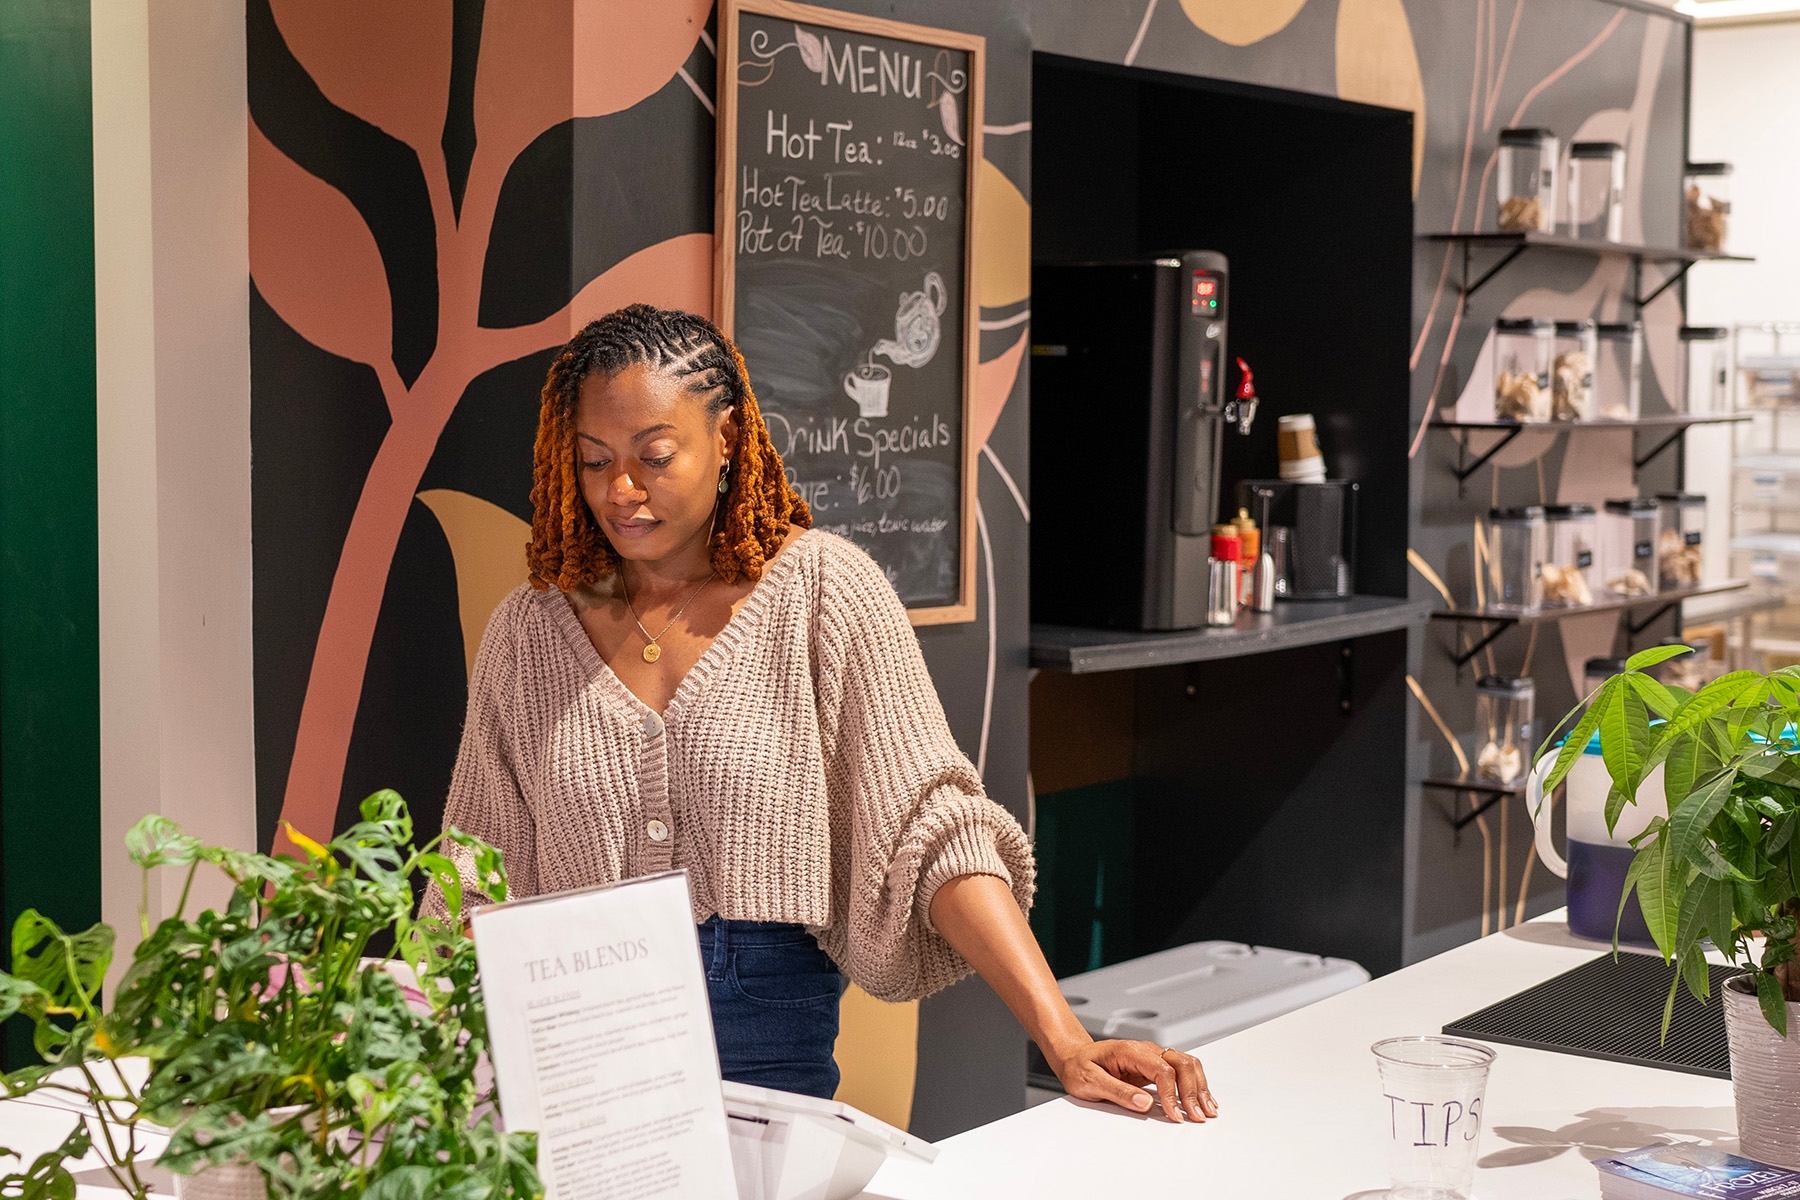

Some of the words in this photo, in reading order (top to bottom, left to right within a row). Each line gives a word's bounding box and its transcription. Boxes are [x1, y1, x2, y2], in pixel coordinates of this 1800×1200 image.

[820, 35, 922, 99] MENU
[766, 109, 822, 160] Hot
[826, 120, 883, 165] Tea:
[743, 165, 784, 209] Hot
[784, 175, 824, 212] Tea
[824, 172, 890, 218] Latte:
[894, 186, 949, 221] $5.00
[737, 210, 774, 255] Pot
[777, 214, 803, 253] of
[853, 413, 951, 470] Specials
[849, 461, 901, 505] $6.00
[524, 956, 568, 983] TEA
[572, 937, 649, 973] BLENDS
[1383, 1093, 1480, 1147] TIPS
[1698, 1167, 1790, 1194] FROZEN
